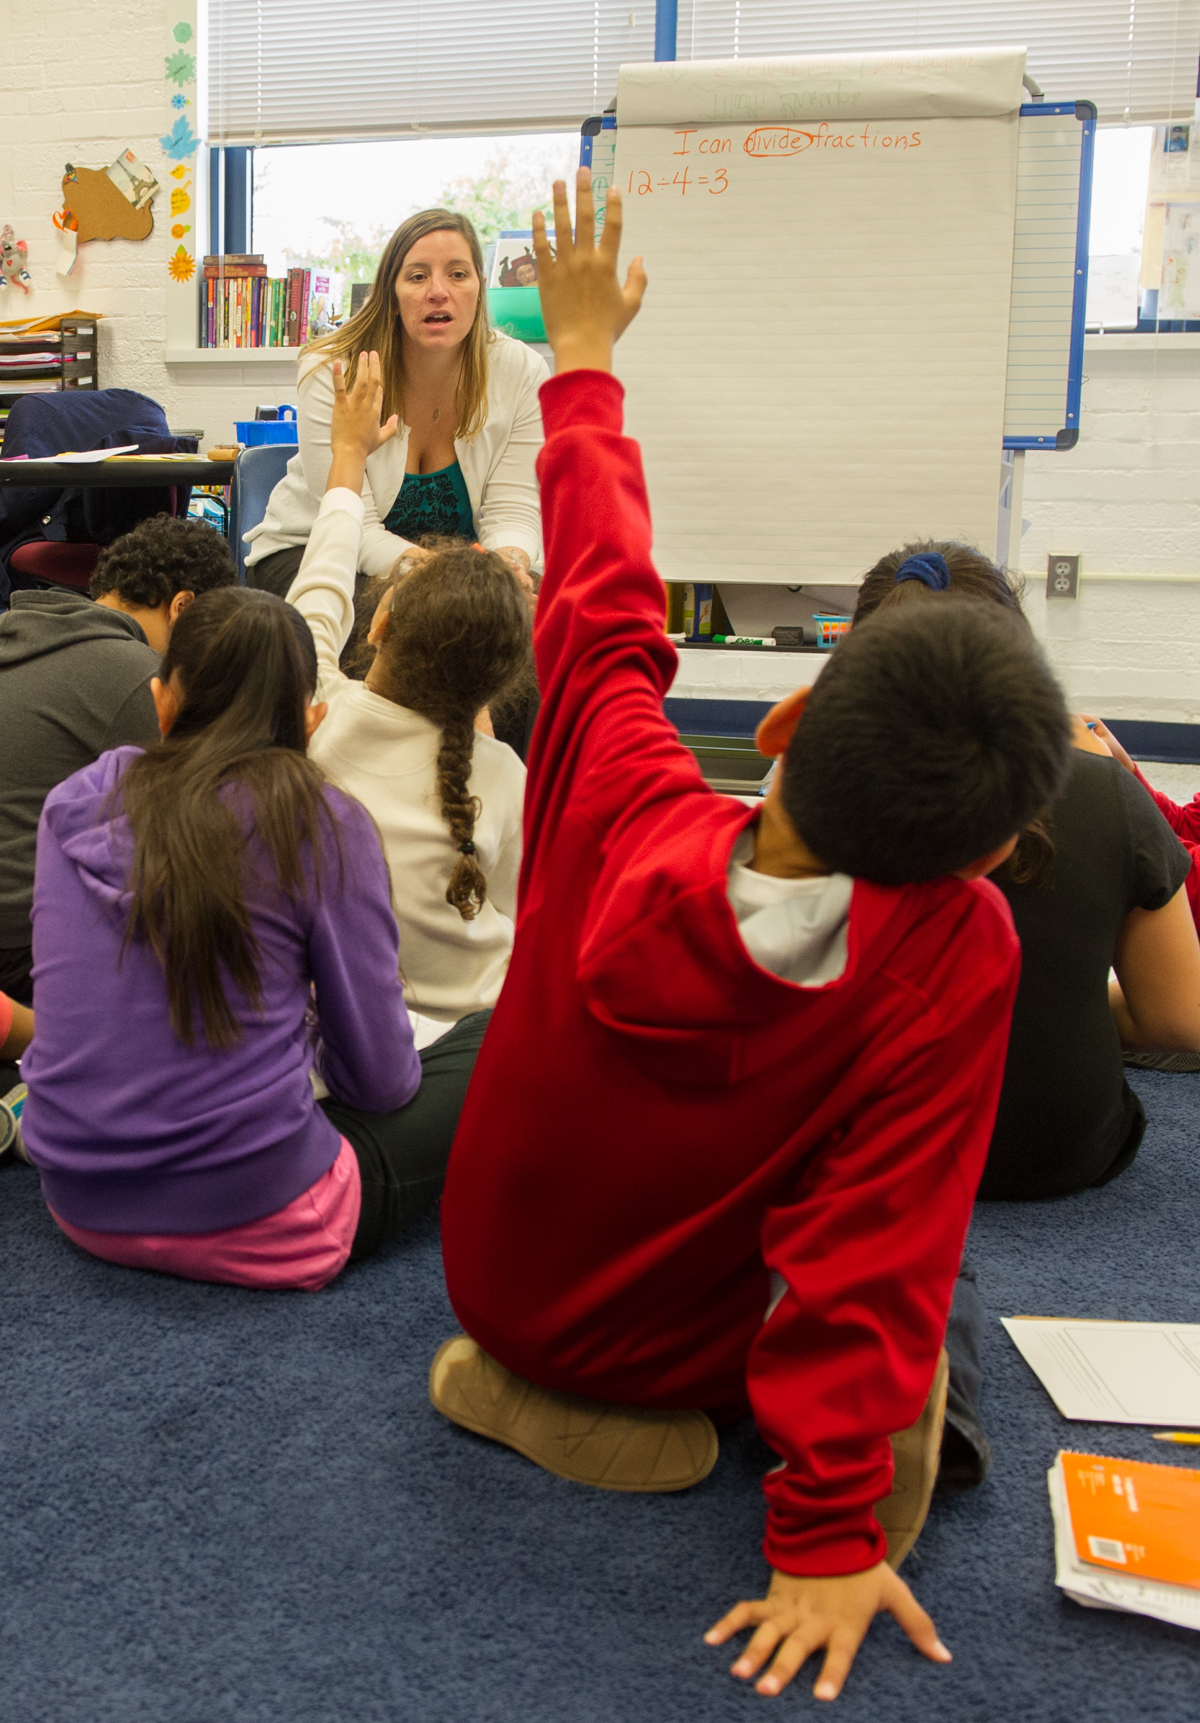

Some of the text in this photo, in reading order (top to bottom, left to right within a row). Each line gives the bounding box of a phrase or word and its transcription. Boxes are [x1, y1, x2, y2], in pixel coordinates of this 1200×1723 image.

[673, 122, 922, 156] I can divide fractions
